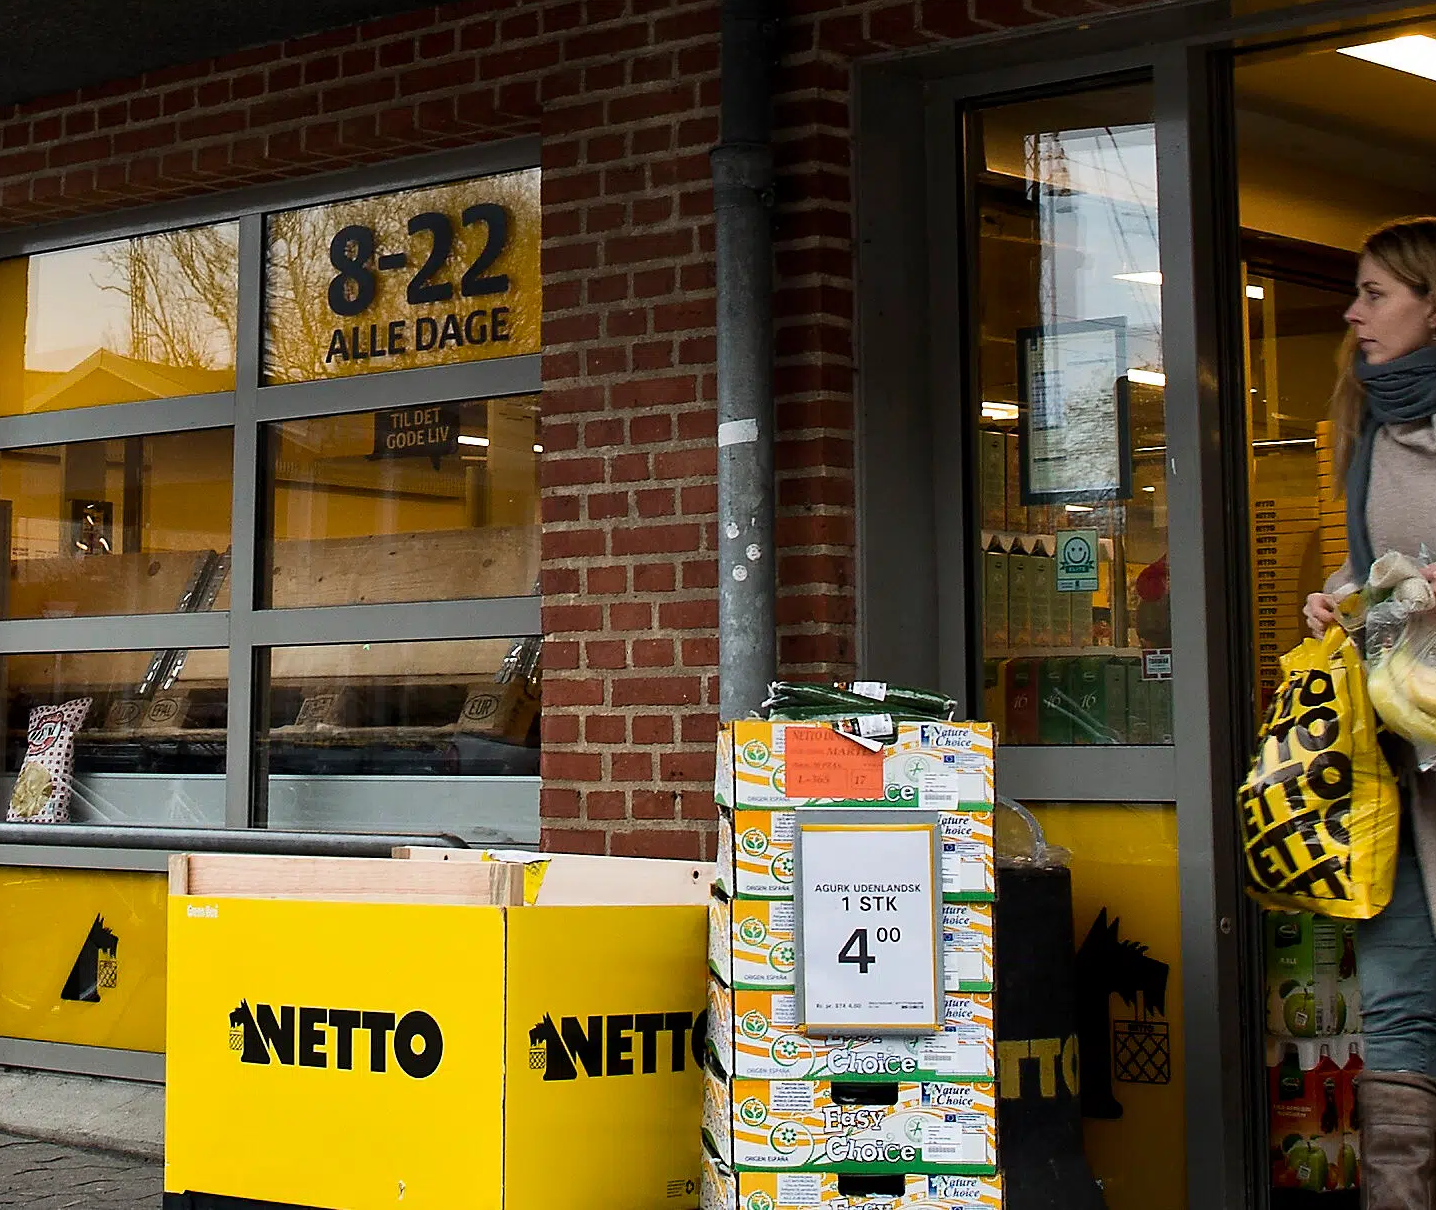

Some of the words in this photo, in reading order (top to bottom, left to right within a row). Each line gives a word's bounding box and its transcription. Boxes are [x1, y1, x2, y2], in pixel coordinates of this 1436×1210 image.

[327, 201, 510, 317] 8-22
[325, 319, 406, 363] ALLE
[415, 306, 511, 353] DAGE
[390, 412, 411, 429] TIL
[414, 406, 441, 425] DET
[386, 430, 425, 449] GODE
[428, 426, 449, 444] LIV
[469, 698, 493, 715] EUR
[932, 726, 969, 739] Nature
[935, 736, 972, 747] Choice
[945, 826, 972, 835] hoice
[815, 884, 850, 893] AGURK
[853, 884, 921, 893] UDENLANDSK
[842, 896, 849, 911] 1
[859, 896, 898, 912] STK
[943, 916, 970, 925] hoice
[945, 1008, 972, 1018] hoice
[253, 1002, 444, 1079] NETTO
[827, 1048, 916, 1075] Choice
[933, 1083, 971, 1095] Nature
[937, 1093, 974, 1105] Choice
[822, 1106, 885, 1134] Easy
[825, 1134, 916, 1163] Choice
[942, 1176, 977, 1188] Nature
[944, 1186, 980, 1198] Choice
